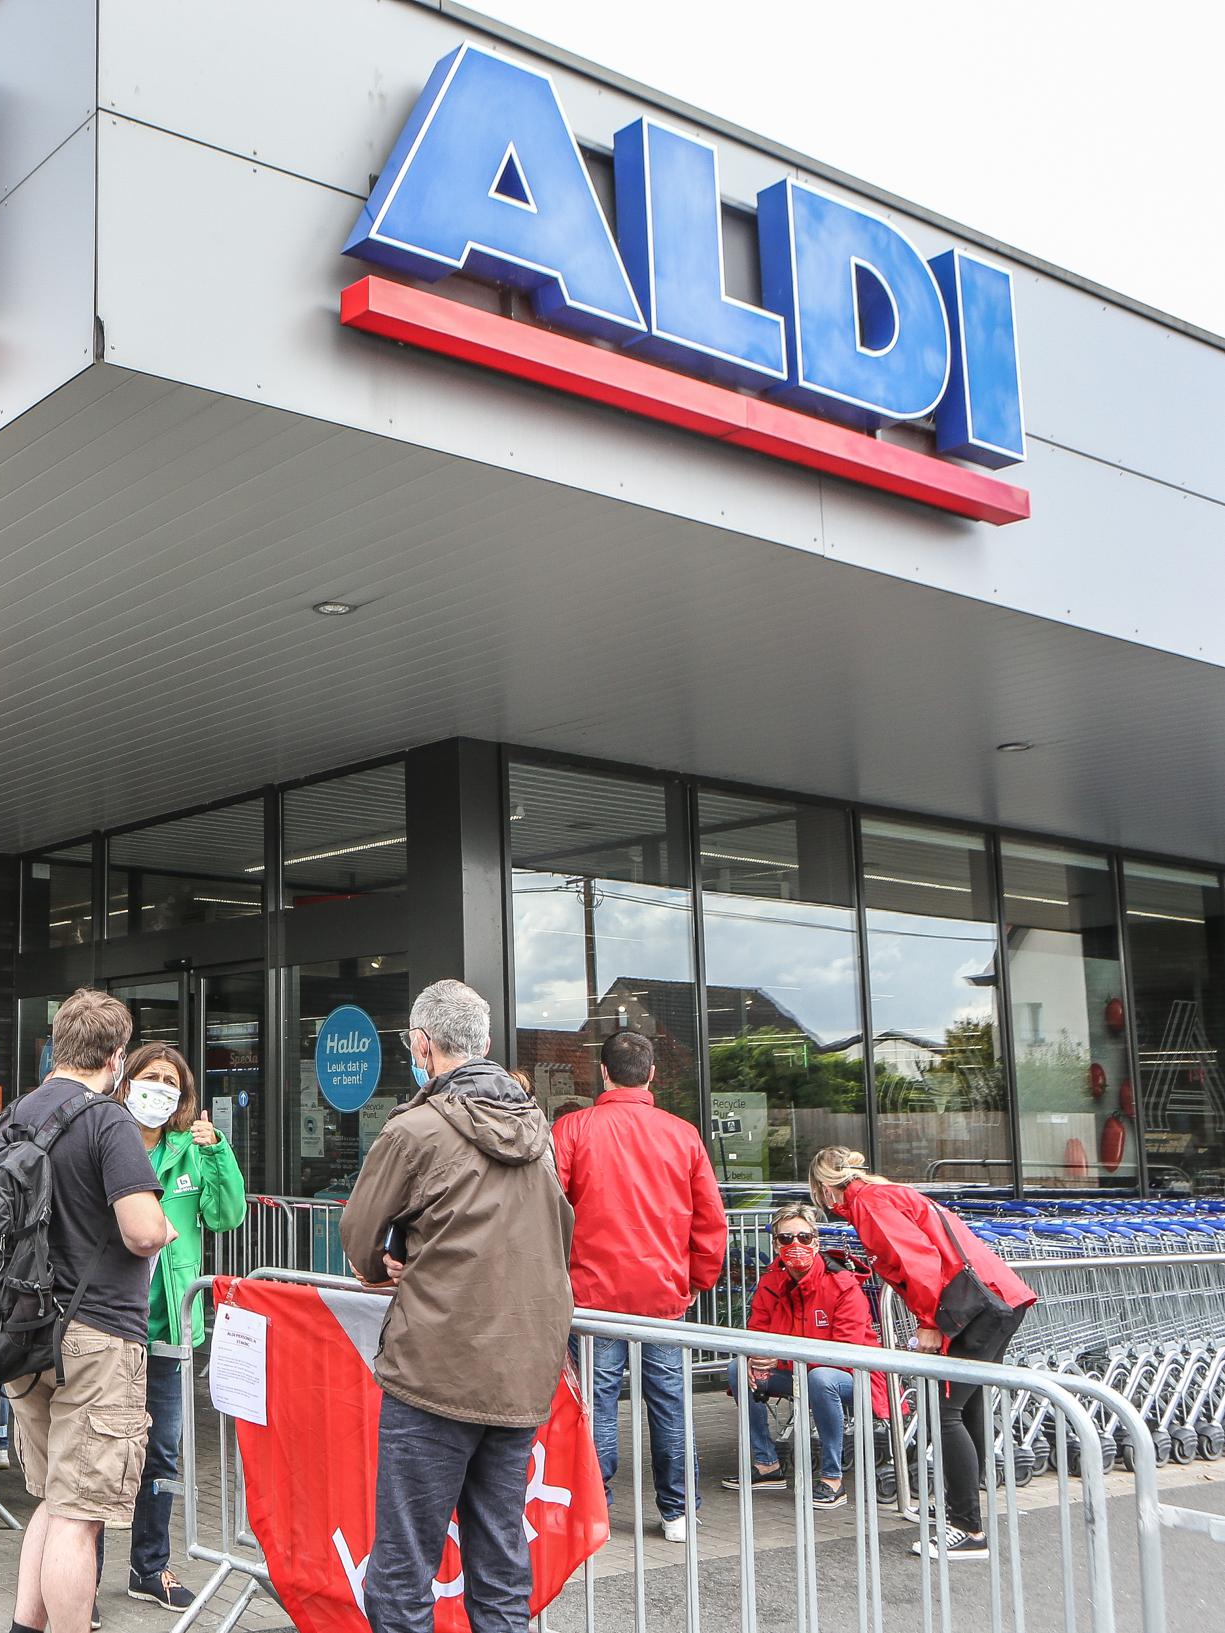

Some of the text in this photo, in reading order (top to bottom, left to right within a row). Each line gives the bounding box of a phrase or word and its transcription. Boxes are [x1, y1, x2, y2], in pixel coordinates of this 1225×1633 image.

[341, 40, 1026, 470] ALDI
[326, 1031, 372, 1055] Hallo
[327, 1060, 368, 1073] Leuk dat je
[332, 1074, 363, 1085] er bent!
[713, 1099, 746, 1111] Recycle
